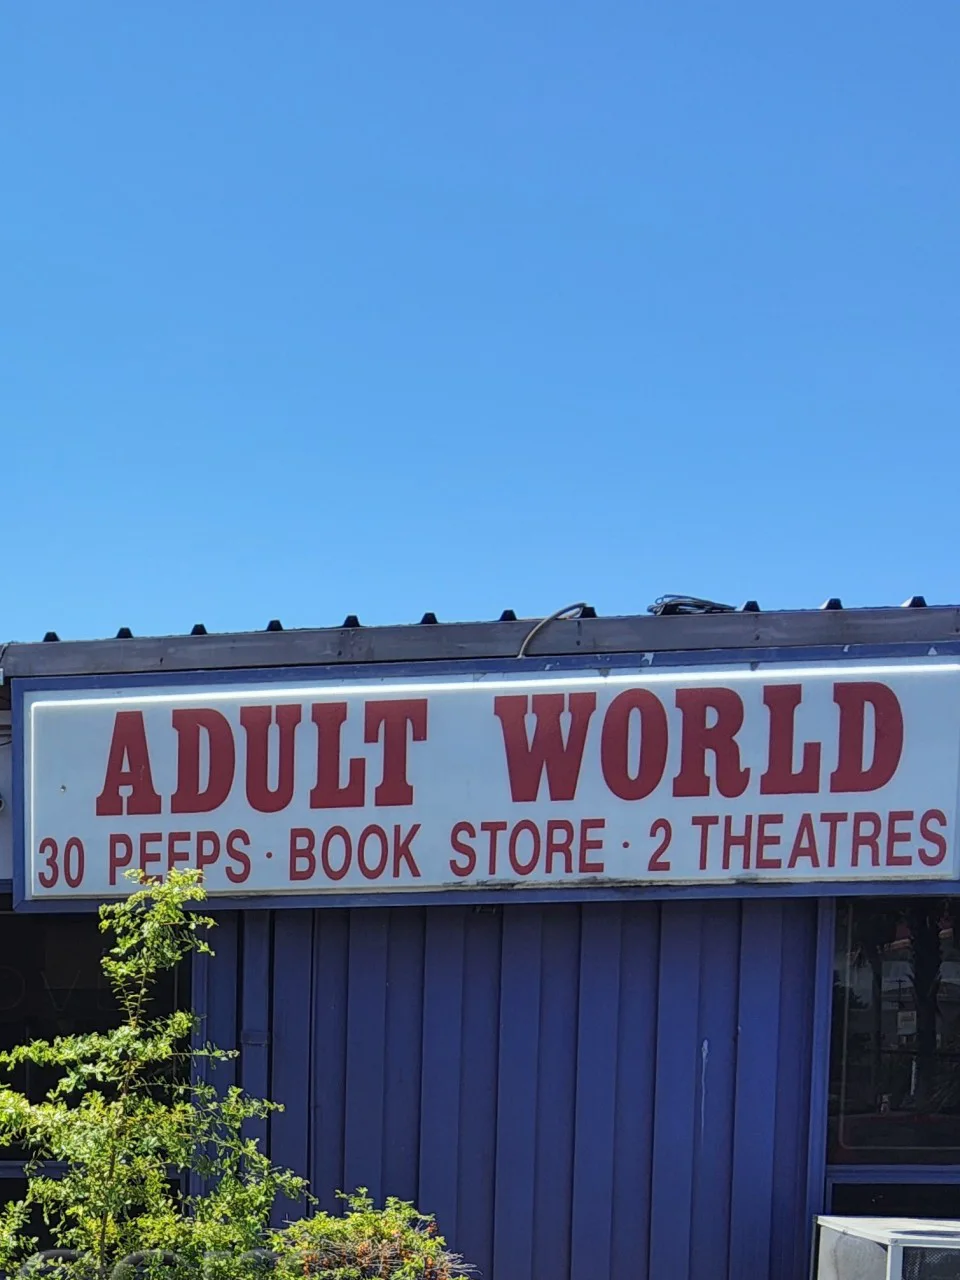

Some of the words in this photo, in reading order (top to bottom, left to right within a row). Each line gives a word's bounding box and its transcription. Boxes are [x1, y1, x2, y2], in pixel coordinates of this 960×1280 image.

[96, 699, 428, 816] ADULT
[494, 682, 903, 802] WORLD
[39, 837, 84, 888] 30
[109, 829, 251, 885] PEEPS
[289, 824, 421, 880] BOOK
[450, 818, 605, 876] STORE
[647, 819, 672, 871] 2
[692, 809, 947, 871] THEATRES
